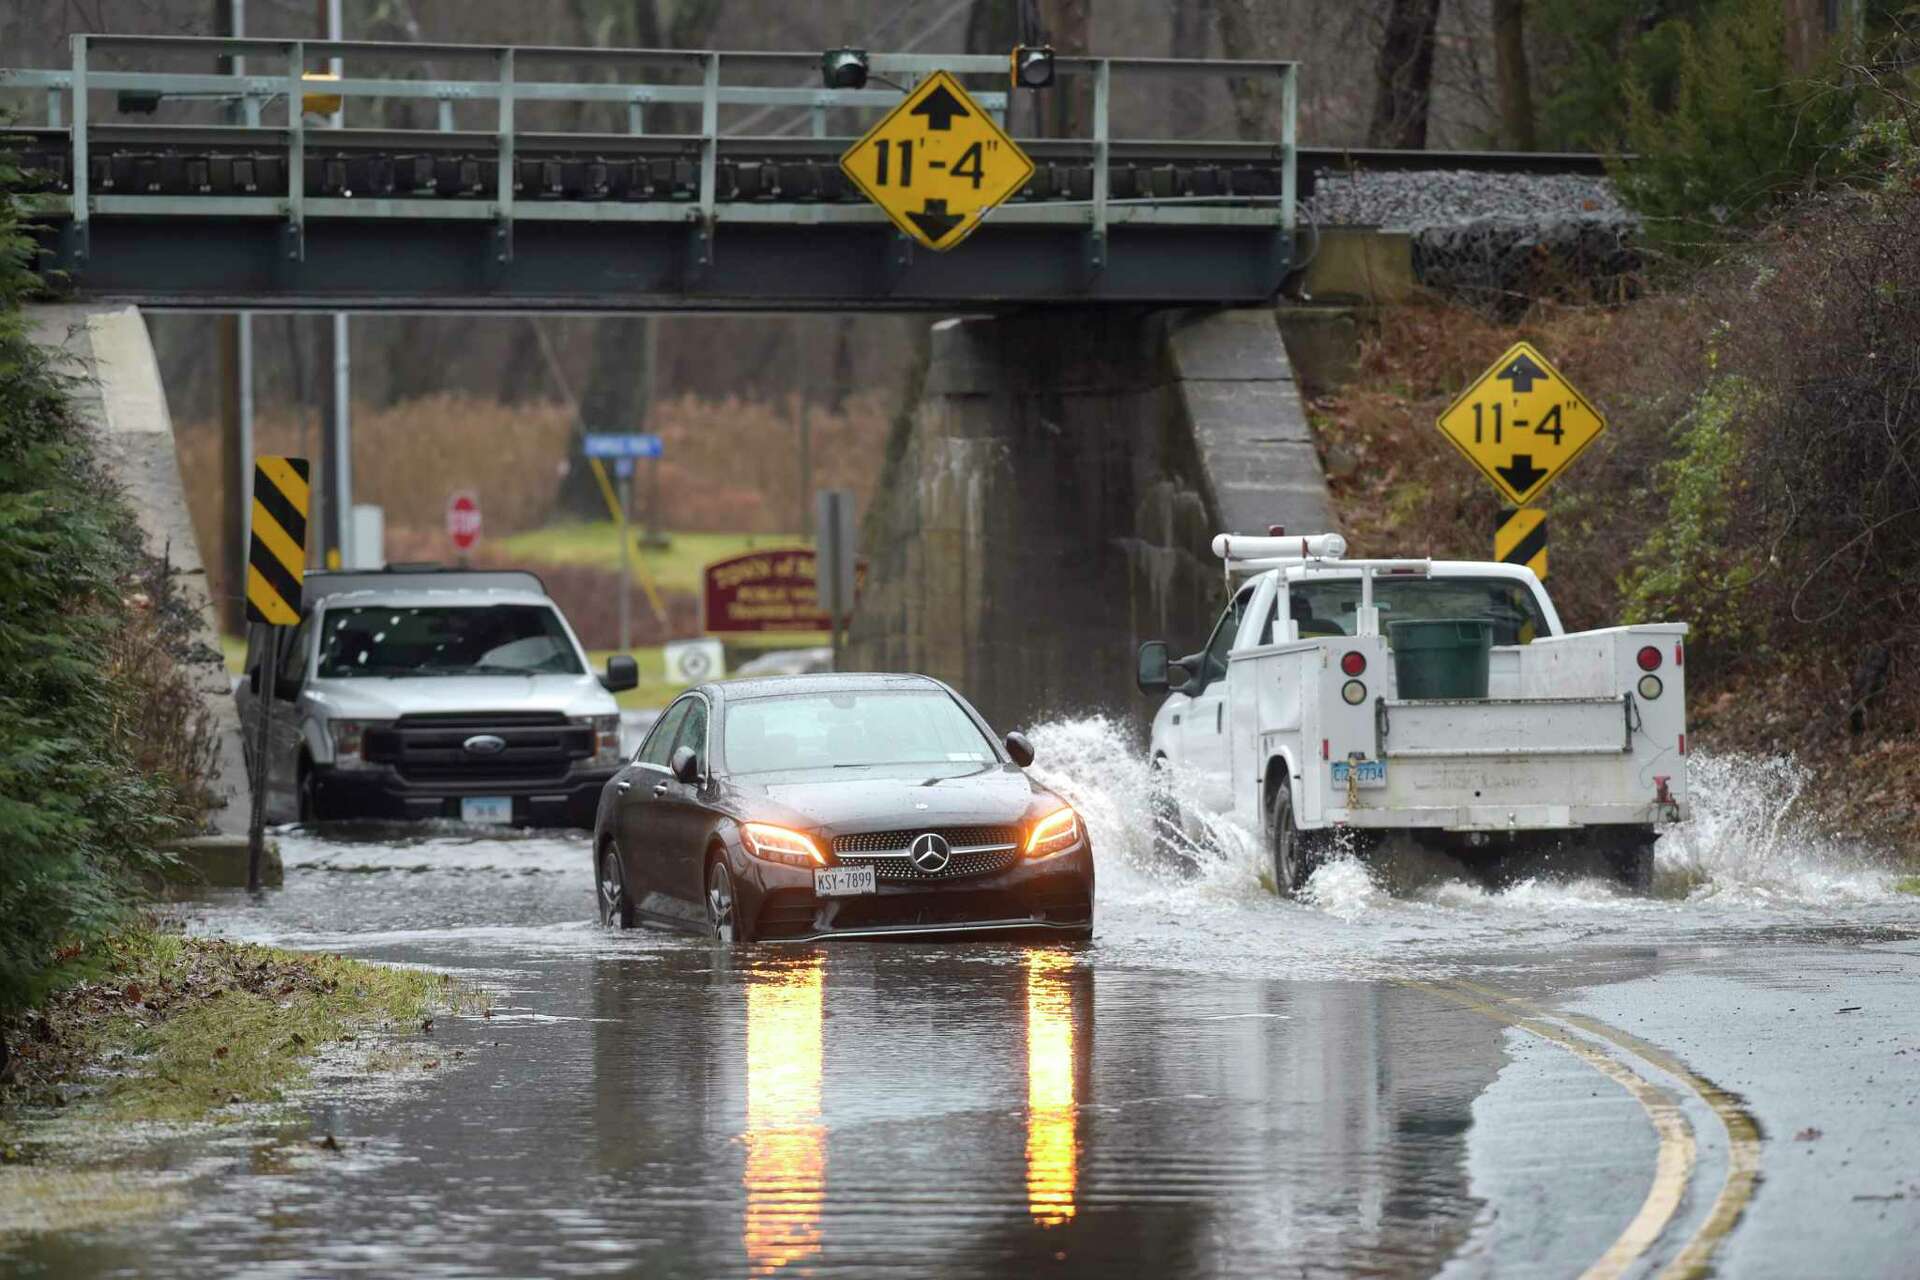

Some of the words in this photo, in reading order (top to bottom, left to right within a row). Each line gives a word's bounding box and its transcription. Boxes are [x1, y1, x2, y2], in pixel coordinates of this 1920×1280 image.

[874, 137, 997, 189] 11'-4"
[1472, 399, 1577, 446] 11'-4"
[450, 511, 480, 533] STOP
